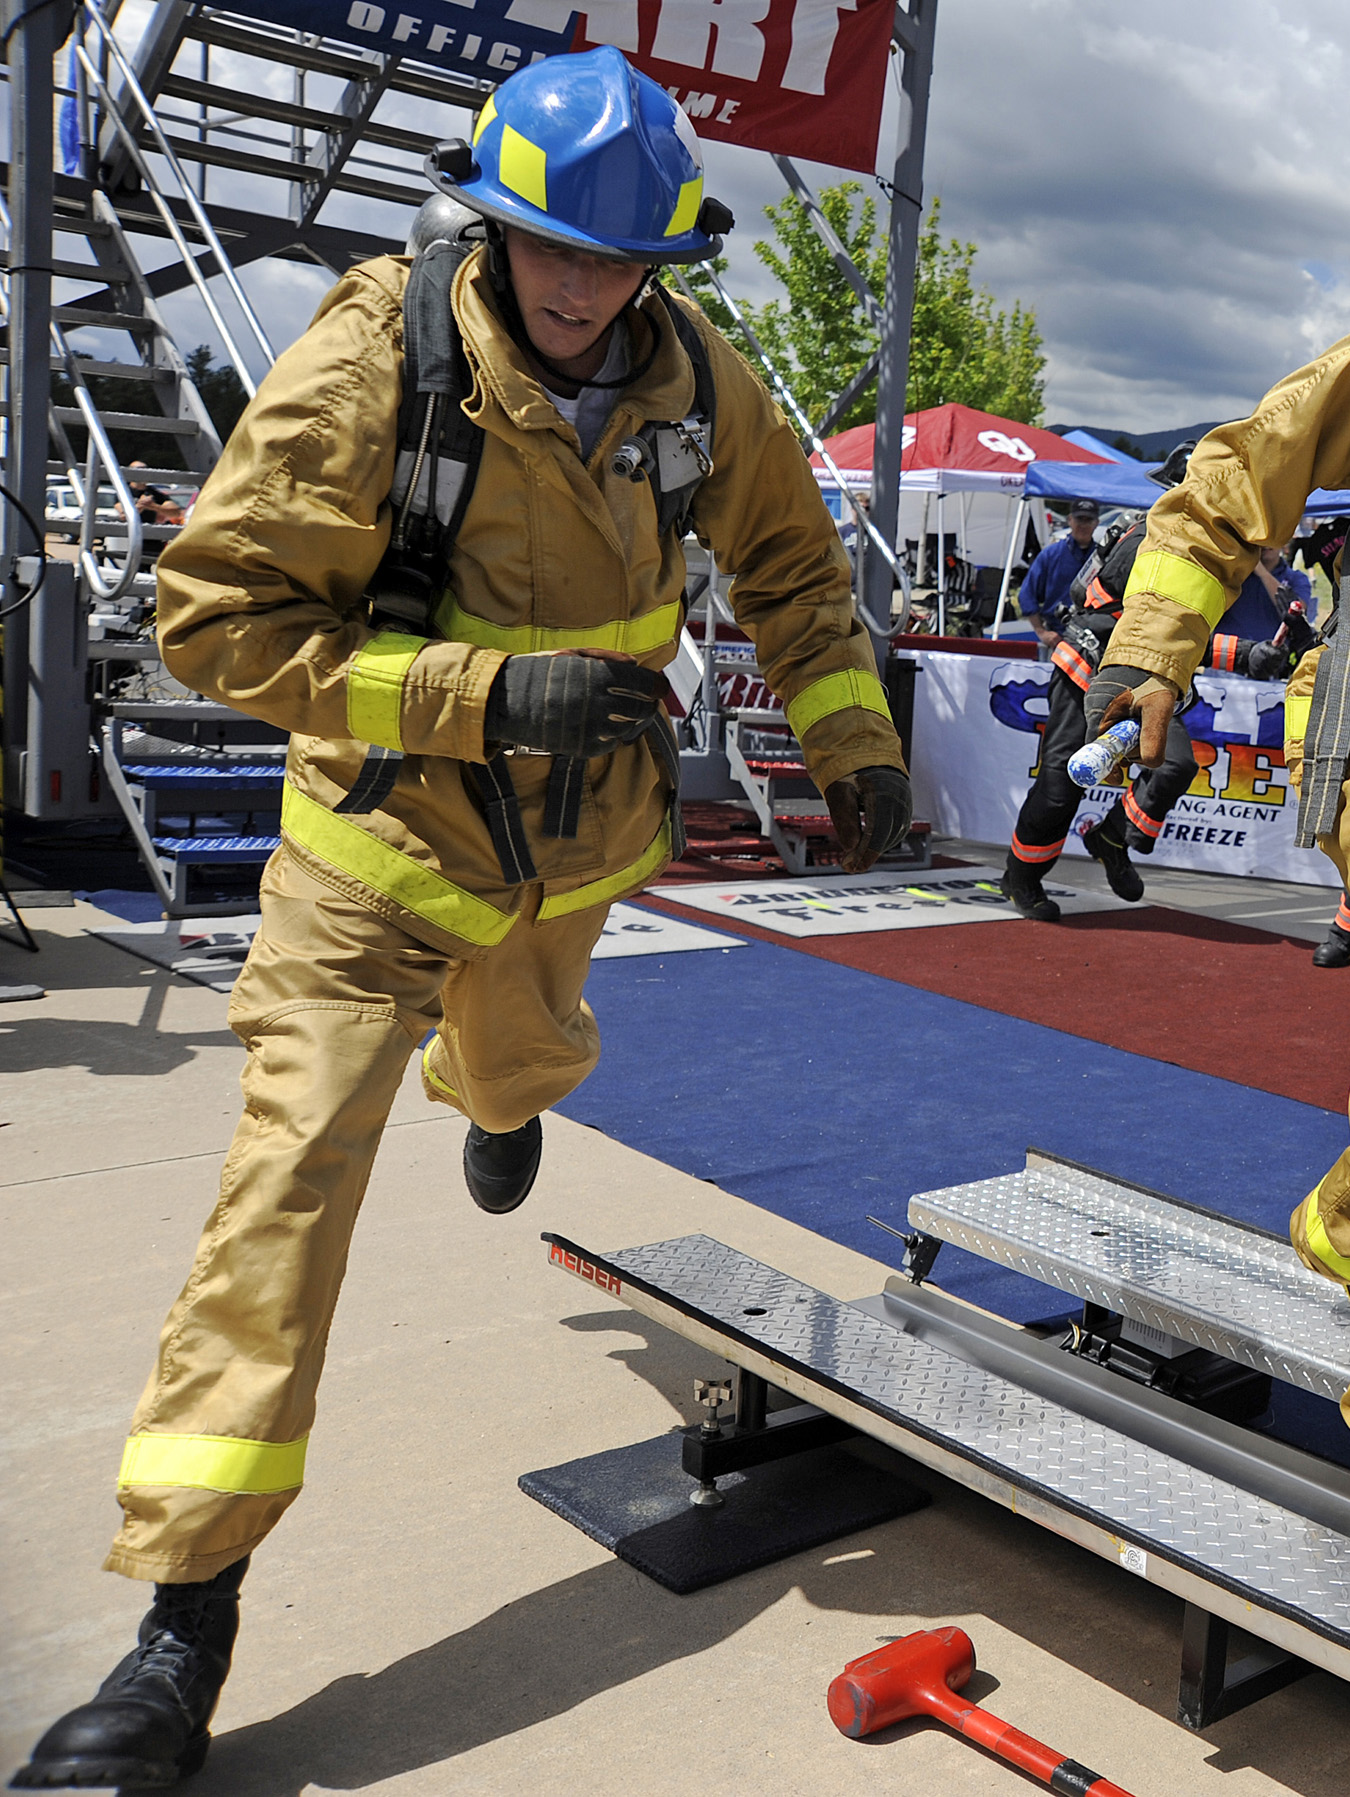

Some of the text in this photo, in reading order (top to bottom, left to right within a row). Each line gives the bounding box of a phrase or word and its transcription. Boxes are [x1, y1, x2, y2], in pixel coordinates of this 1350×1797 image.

[656, 82, 741, 125] IME
[1213, 803, 1281, 823] AGENT
[1162, 823, 1247, 848] FREEZE
